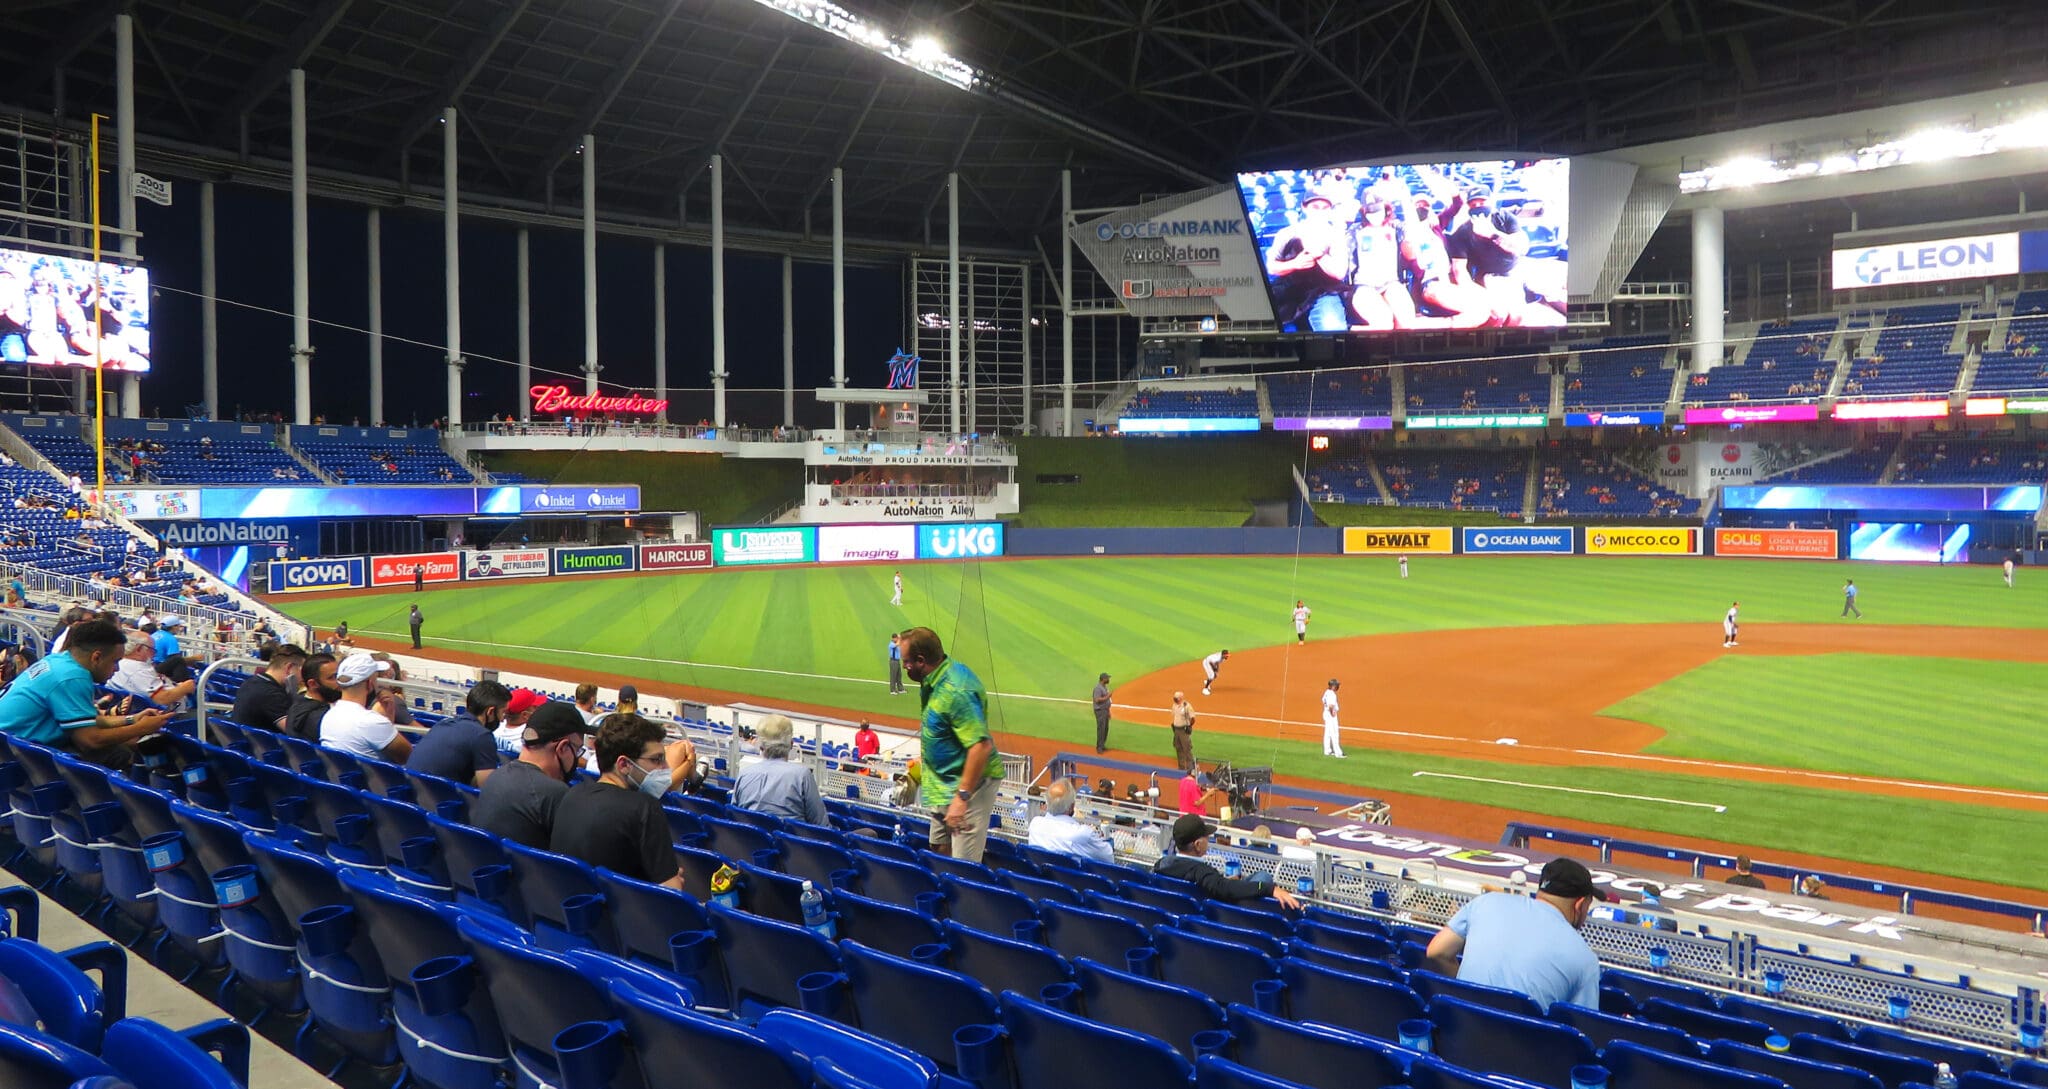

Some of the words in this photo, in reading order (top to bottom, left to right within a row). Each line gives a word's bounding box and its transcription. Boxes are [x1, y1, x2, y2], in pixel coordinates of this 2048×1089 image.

[140, 176, 164, 192] 2003
[1122, 245, 1220, 262] AutoNation
[1897, 241, 1994, 271] LEON
[529, 384, 669, 414] Budweiser
[1601, 413, 1641, 426] Fanatics
[838, 455, 873, 463] AutoNation
[924, 456, 968, 464] PARTNERS
[550, 494, 575, 506] Inktel
[601, 494, 626, 506] Inktel
[885, 505, 943, 517] AutoNation
[951, 505, 974, 517] Alley
[166, 521, 289, 543] AutoNation
[1490, 535, 1528, 545] OCEAN
[1531, 535, 1561, 545] BANK
[1609, 535, 1680, 545] MICCO.CO
[1722, 533, 1762, 546] SOLIS
[1769, 537, 1796, 545] LOCAL
[648, 550, 706, 563] HAIRCLUB
[843, 548, 899, 559] imaging
[502, 562, 512, 570] GET
[288, 564, 346, 586] GOYA
[1694, 892, 1903, 940] park
